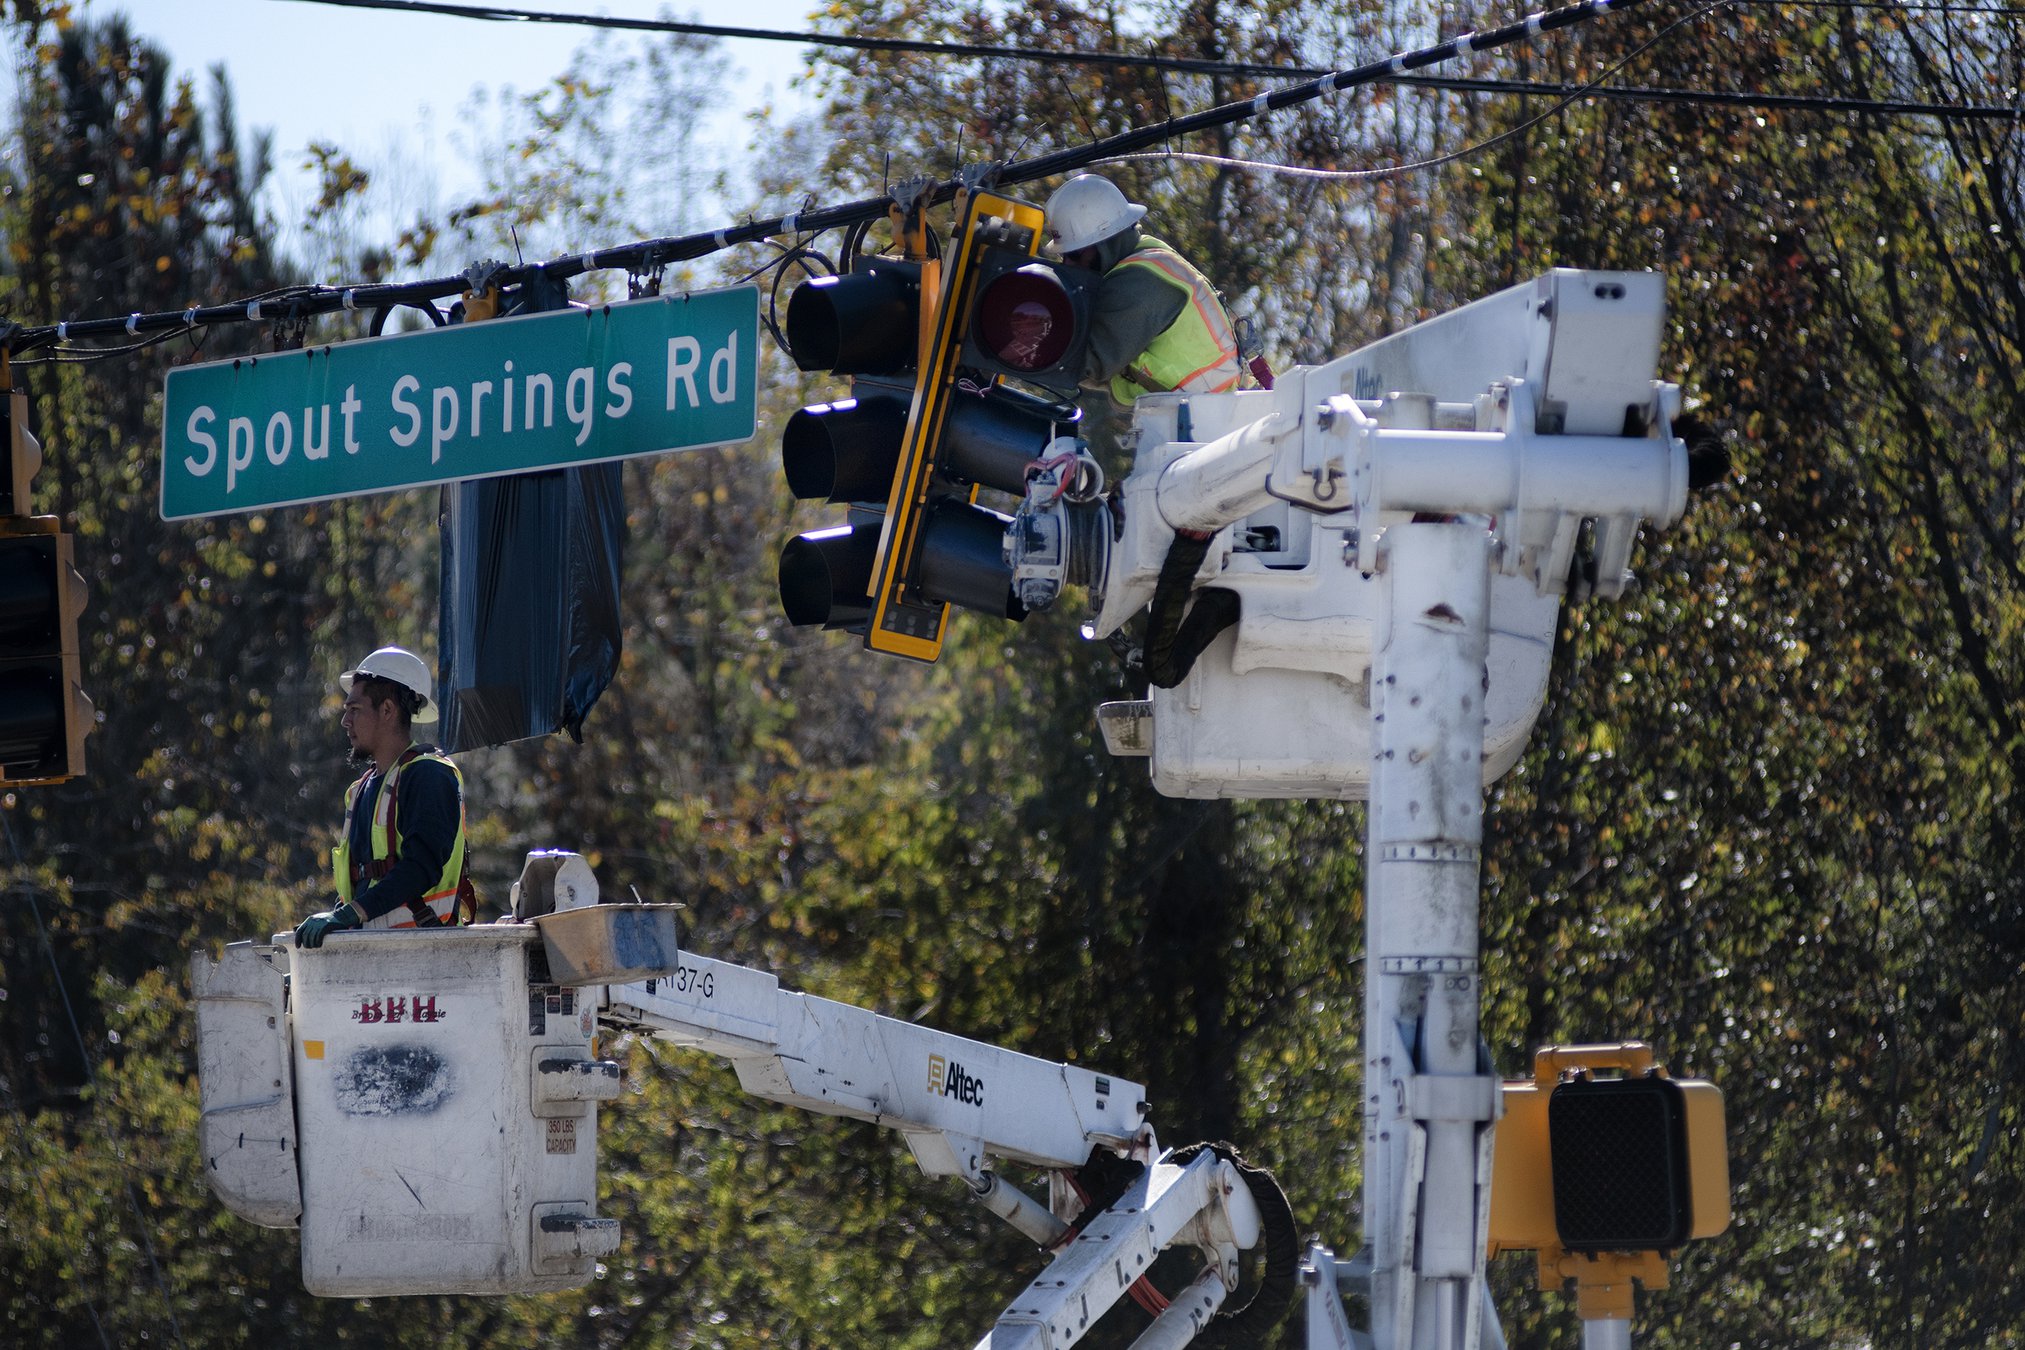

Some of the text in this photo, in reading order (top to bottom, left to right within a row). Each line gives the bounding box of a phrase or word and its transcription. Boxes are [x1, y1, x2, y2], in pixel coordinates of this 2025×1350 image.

[184, 329, 738, 494] Spout Springs Rd
[944, 1061, 984, 1107] Altec
[549, 1119, 574, 1133] 350 LBS
[546, 1138, 576, 1153] CAPACITY
